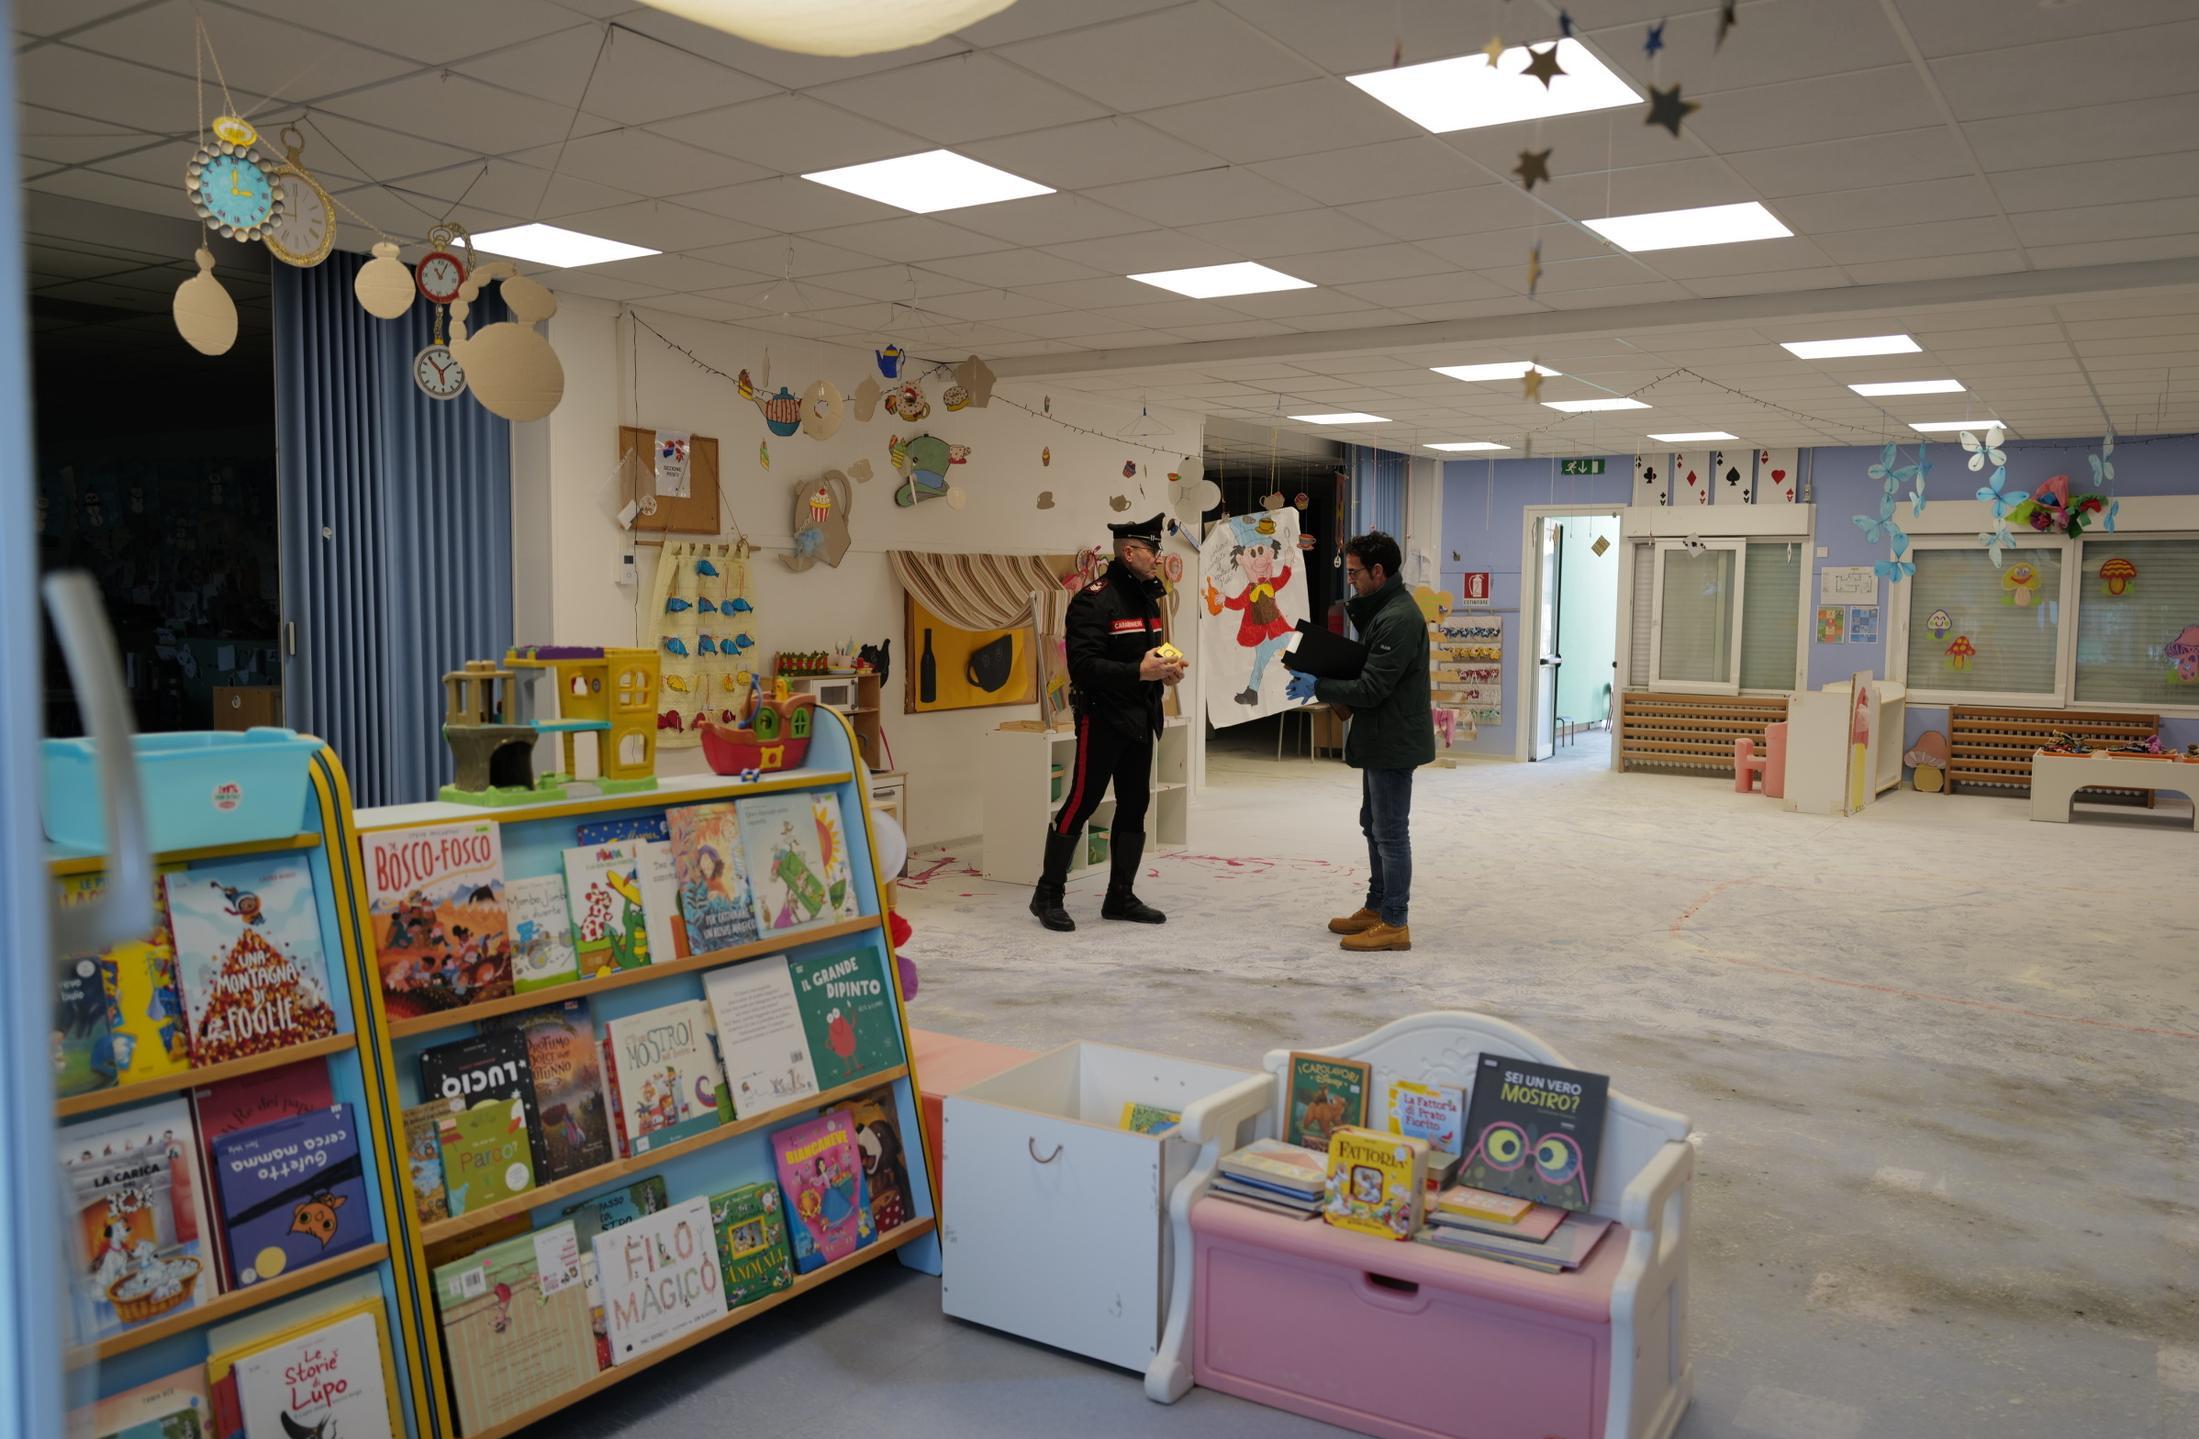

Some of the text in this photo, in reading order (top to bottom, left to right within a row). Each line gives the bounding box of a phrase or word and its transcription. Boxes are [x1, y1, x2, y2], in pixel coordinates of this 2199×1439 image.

[375, 834, 491, 892] BOSCO-FOSCO
[239, 950, 265, 967] UNA
[801, 956, 859, 992] IL GRANDE
[217, 962, 297, 995] MONTAGNA
[826, 978, 881, 999] DIPINTO
[253, 989, 265, 1001] DI
[227, 997, 298, 1041] FOGLIE
[442, 1061, 518, 1098] LUCIO
[1504, 1070, 1582, 1096] SEI UN VERO
[1404, 1093, 1458, 1113] La Fattoria
[1501, 1082, 1580, 1113] MOSTRO?
[1405, 1106, 1447, 1122] di Prato
[1405, 1115, 1441, 1132] Fiorito
[230, 1130, 346, 1172] cerca mamma
[785, 1130, 849, 1165] BIANCANEVE
[1338, 1140, 1408, 1170] FATTORIA
[93, 1163, 161, 1188] LA CARICA
[258, 1150, 327, 1181] Gufetto
[624, 1220, 693, 1282] FILO
[613, 1256, 717, 1331] MAGICO
[285, 1357, 338, 1386] Storie
[304, 1349, 322, 1364] Le
[292, 1379, 348, 1412] Lupo
